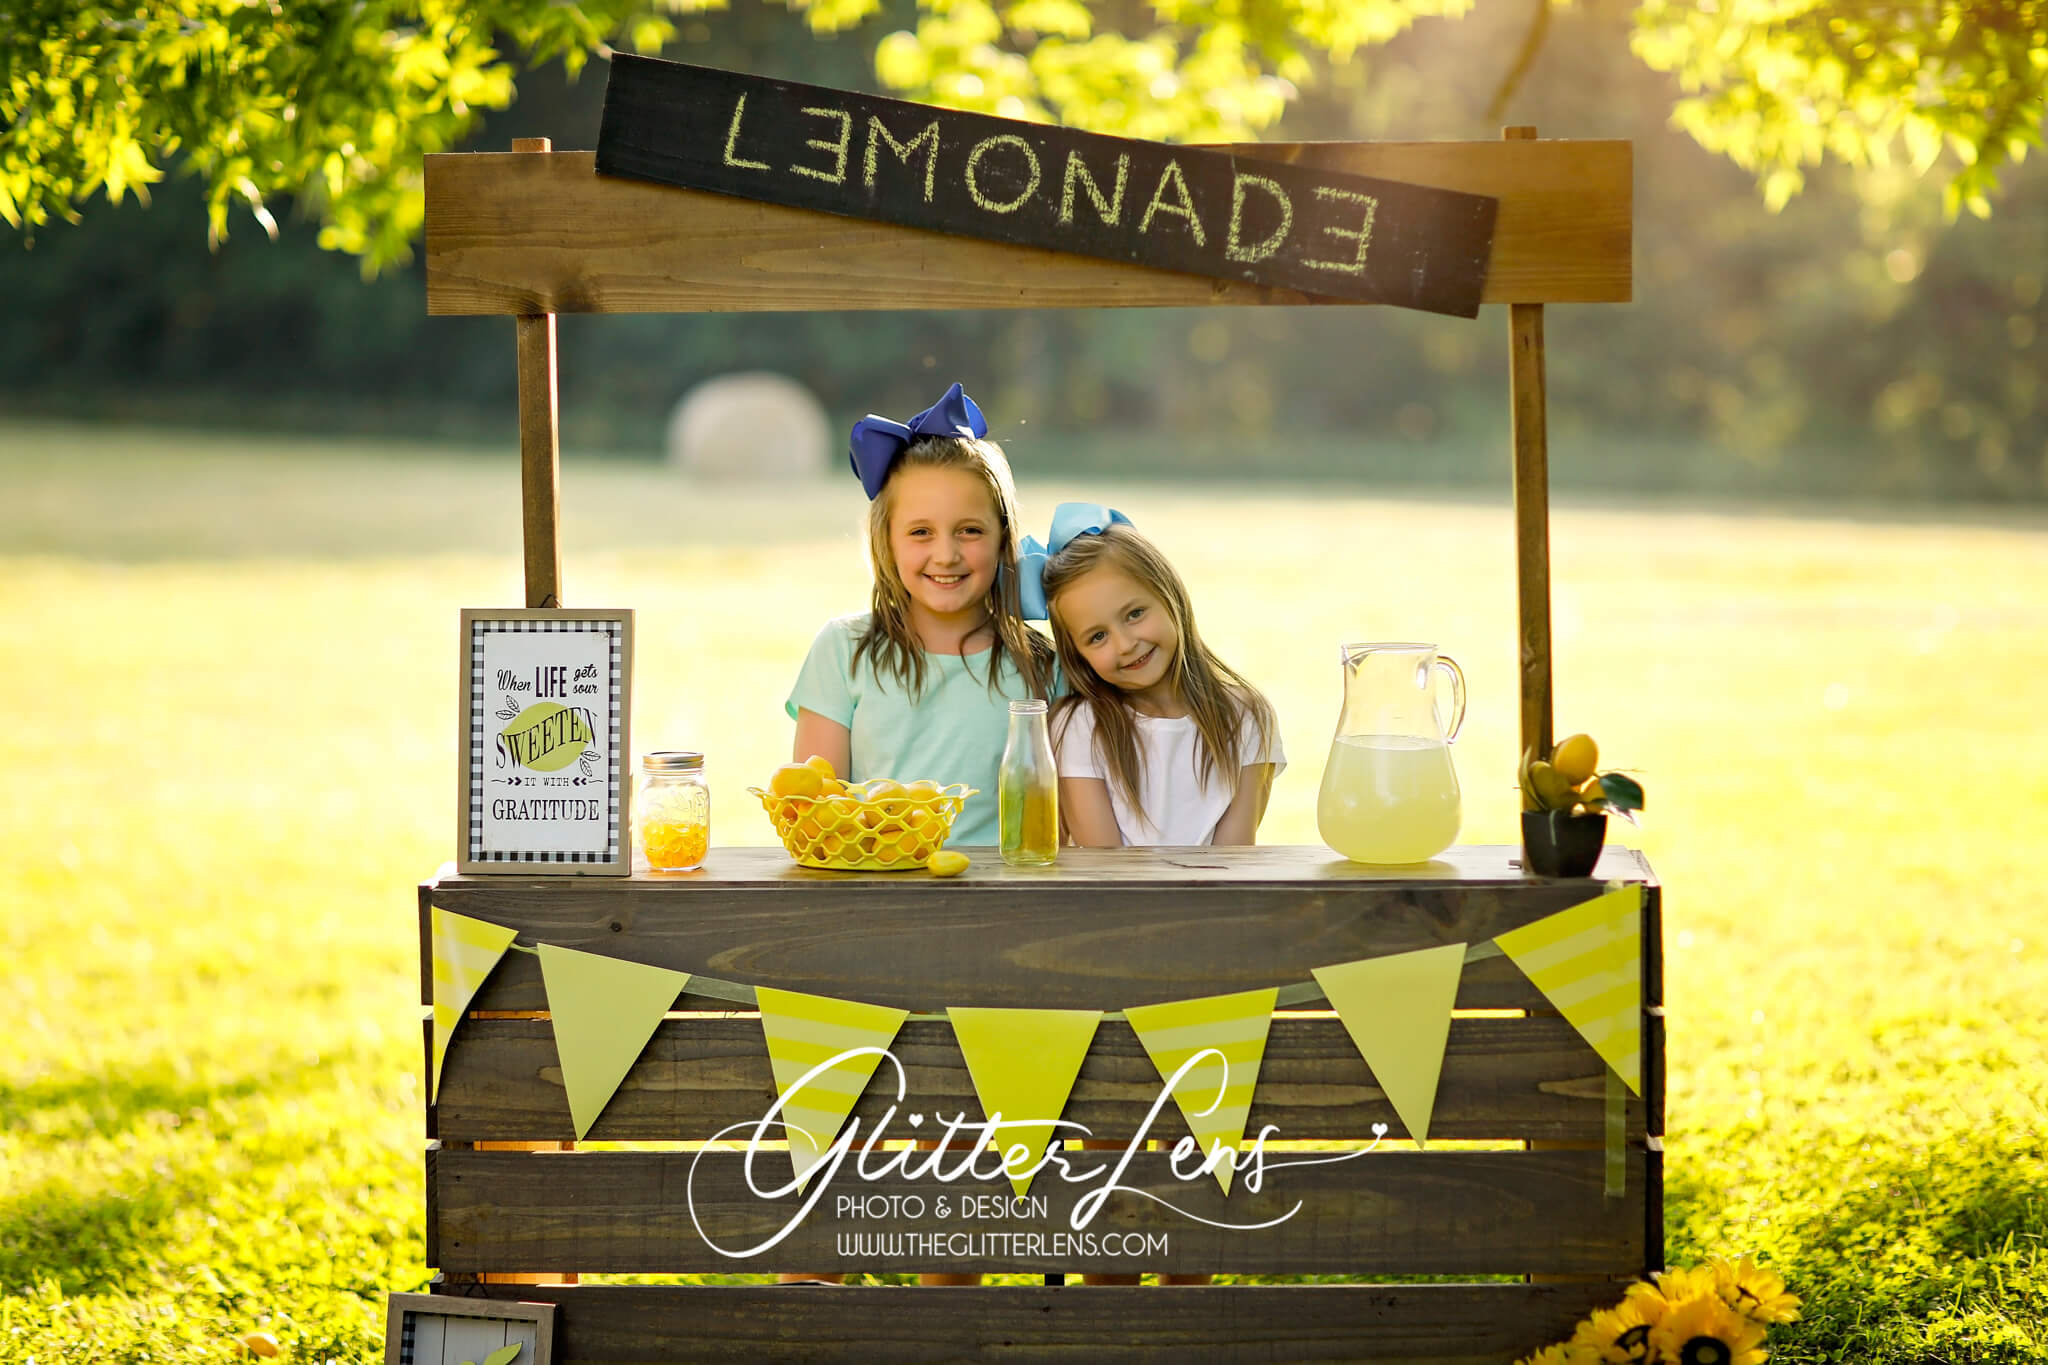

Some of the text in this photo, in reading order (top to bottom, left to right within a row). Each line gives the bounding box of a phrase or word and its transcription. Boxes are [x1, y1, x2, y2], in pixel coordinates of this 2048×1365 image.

[497, 664, 598, 698] When LIFE gets
[573, 683, 599, 695] sour
[495, 707, 598, 769] SWEETEN
[525, 777, 570, 787] IT WITH
[492, 799, 600, 821] GRATITUDE
